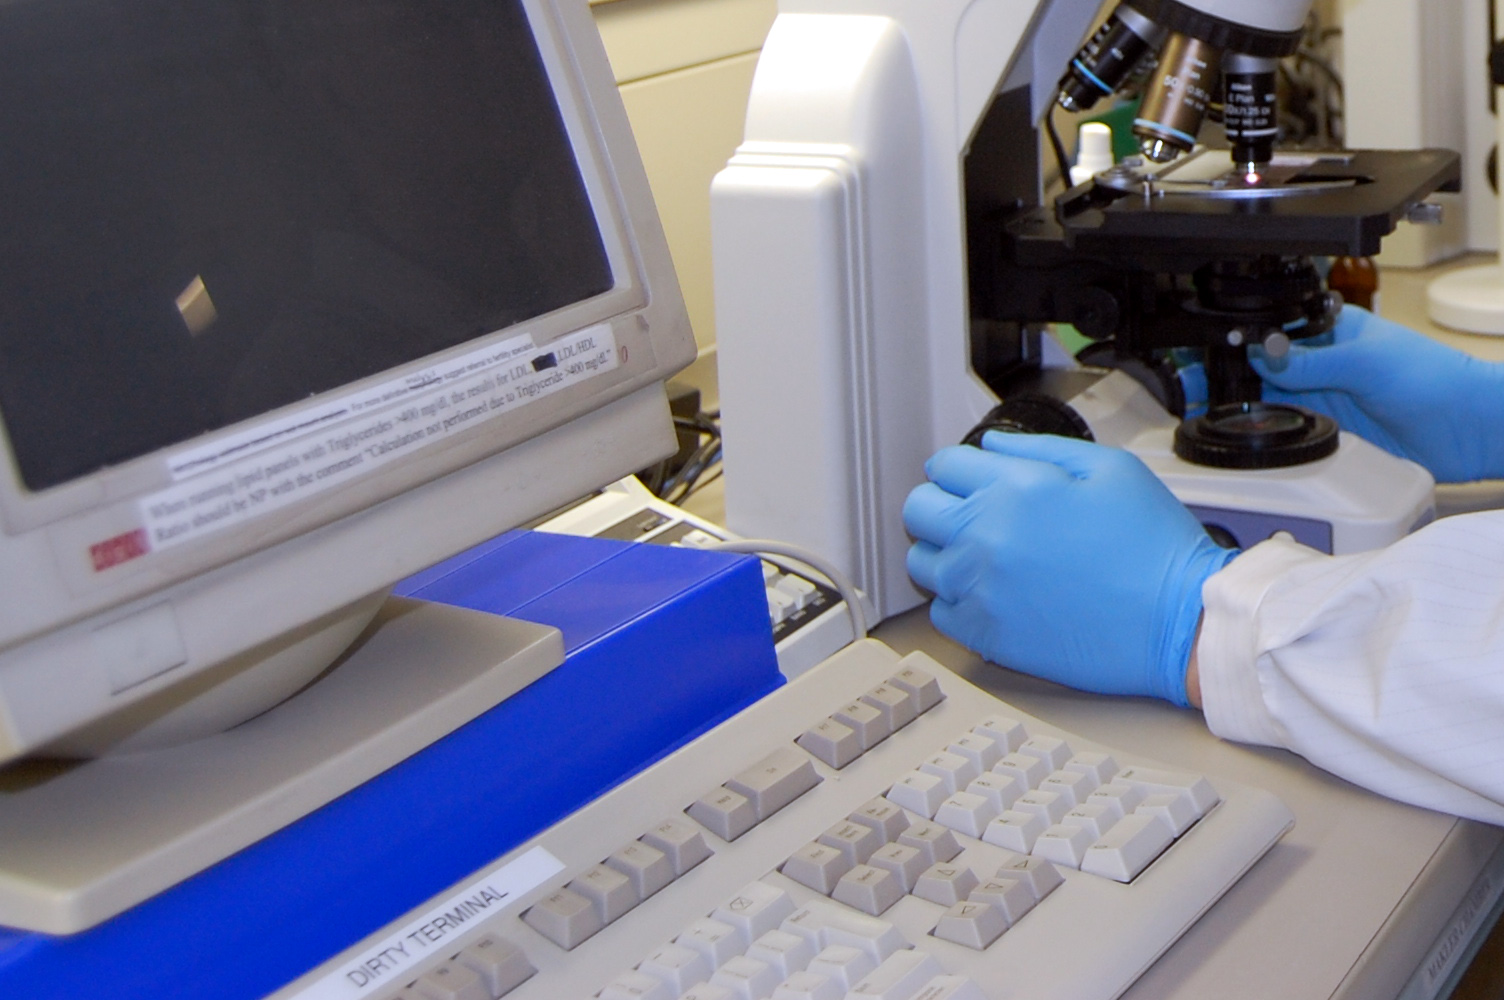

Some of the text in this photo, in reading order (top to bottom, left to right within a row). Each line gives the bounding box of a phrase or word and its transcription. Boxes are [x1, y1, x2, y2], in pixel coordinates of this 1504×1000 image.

[192, 501, 233, 528] should
[233, 499, 248, 512] be
[270, 479, 296, 496] with
[297, 472, 313, 487] the
[316, 452, 364, 479] comment
[426, 420, 442, 436] not
[443, 399, 488, 433] performed
[489, 396, 505, 410] due
[506, 392, 515, 403] to
[515, 369, 563, 399] Triglyceride
[265, 453, 299, 479] panels
[302, 443, 327, 460] with
[326, 419, 394, 453] Triglycerides
[451, 390, 467, 405] the
[467, 379, 496, 399] results
[496, 372, 509, 387] for
[346, 885, 509, 988] DIRTY TERMINAL
